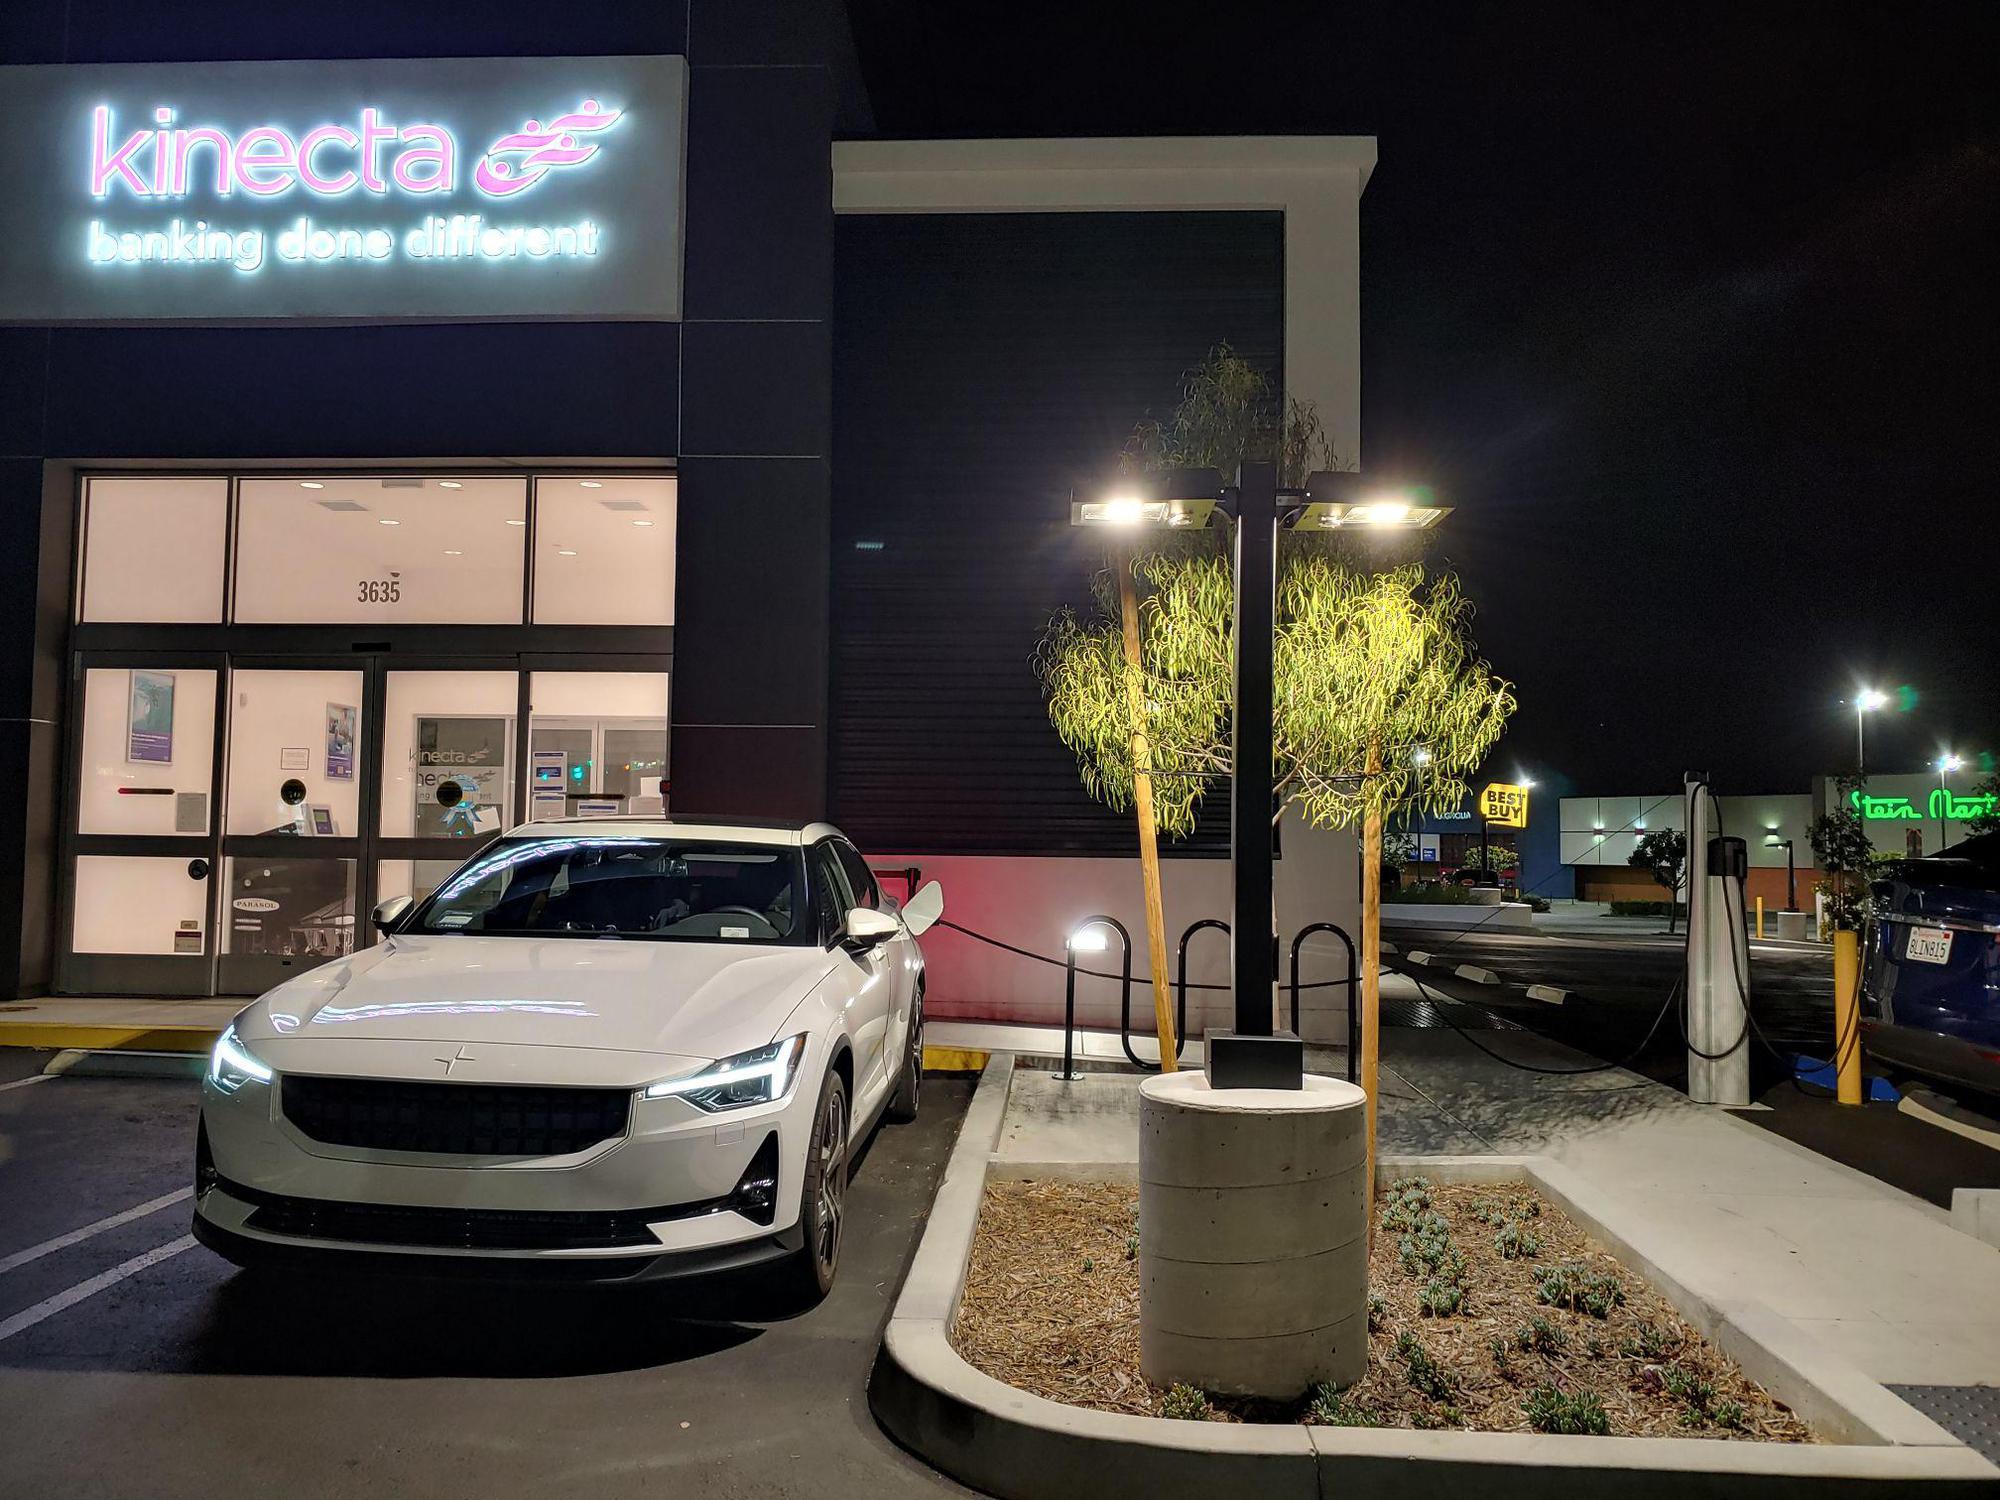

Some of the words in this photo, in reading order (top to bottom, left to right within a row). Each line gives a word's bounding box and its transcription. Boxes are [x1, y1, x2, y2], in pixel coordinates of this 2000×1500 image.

[92, 106, 453, 195] kinecta
[91, 219, 263, 271] banking
[278, 218, 391, 259] done
[405, 215, 597, 258] different
[358, 581, 400, 602] 3635
[1487, 791, 1525, 805] BEST
[1851, 791, 1922, 819] Stein
[1488, 804, 1522, 819] BUY
[236, 901, 277, 909] PARASOL
